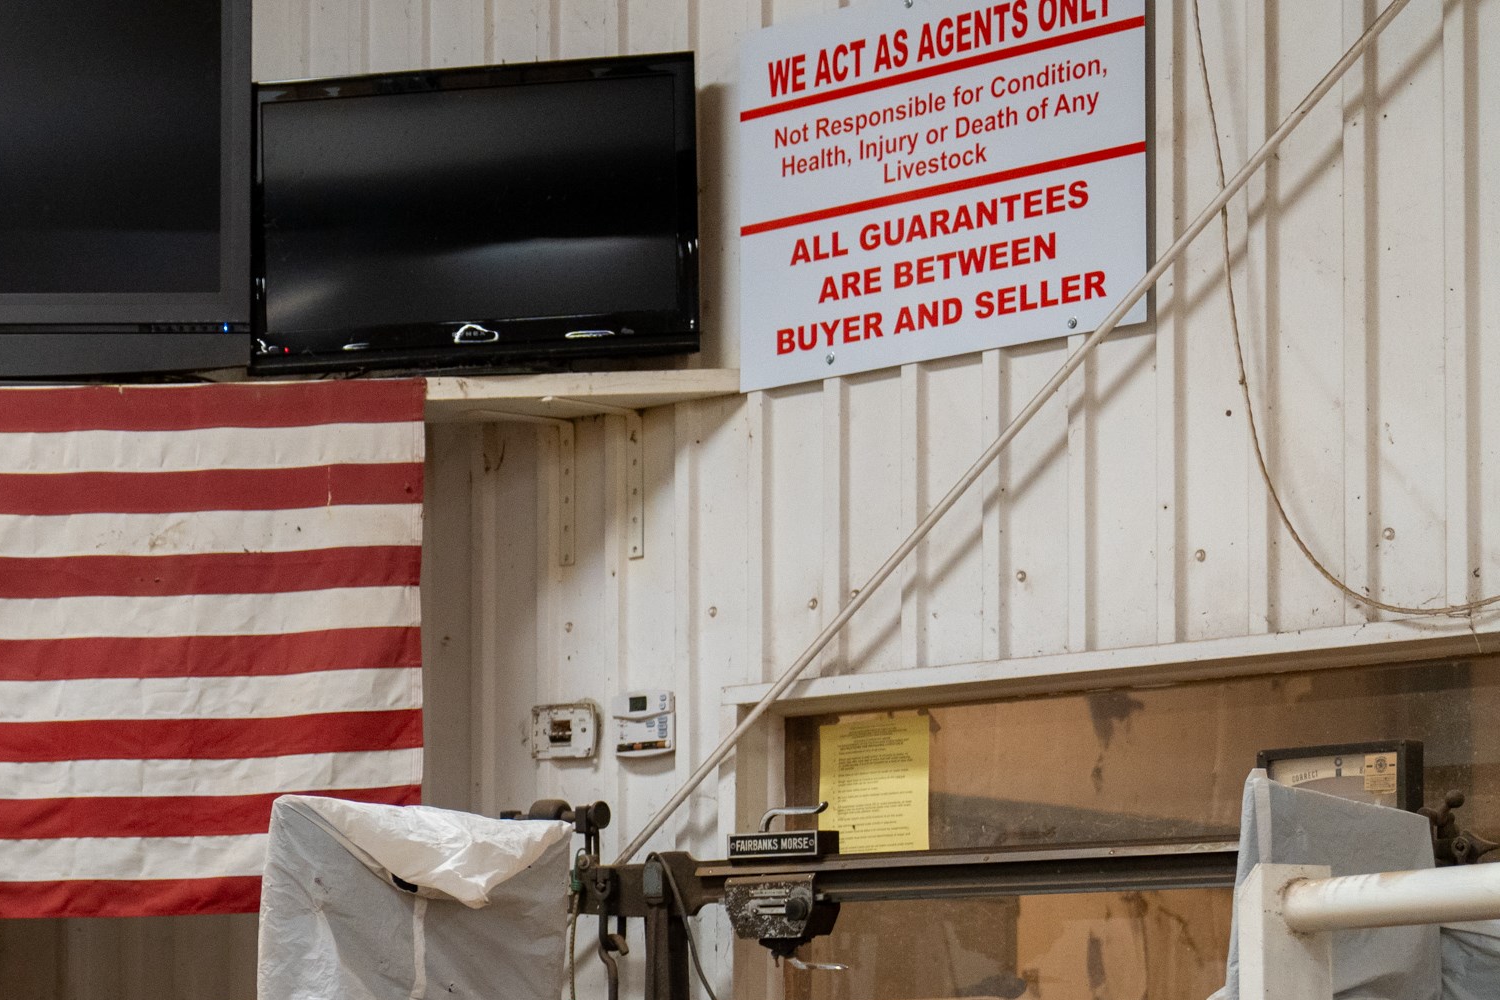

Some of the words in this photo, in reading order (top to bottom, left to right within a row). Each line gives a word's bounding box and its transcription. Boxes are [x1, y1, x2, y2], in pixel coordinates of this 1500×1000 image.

[768, 54, 806, 98] WE
[814, 39, 866, 88] ACT
[874, 29, 909, 73] AS
[917, 0, 1028, 63] AGENTS
[774, 124, 809, 148] Not
[815, 96, 946, 139] Responsible
[953, 86, 984, 108] for
[990, 58, 1108, 98] Condition,
[781, 148, 852, 177] Health,
[860, 131, 918, 162] Injury
[926, 127, 949, 145] or
[956, 108, 1018, 139] Death
[1026, 105, 1049, 122] of
[1054, 91, 1100, 118] Any
[884, 143, 988, 184] Livestock
[790, 238, 849, 266] ALL
[859, 180, 1089, 251] GUARANTEES
[818, 266, 882, 303] ARE
[894, 232, 1056, 289] BETWEEN
[776, 312, 883, 355] BUYER
[894, 297, 963, 334] AND
[975, 270, 1106, 319] SELLER
[736, 838, 779, 852] FAIRBANKS
[781, 837, 809, 850] MORSE
